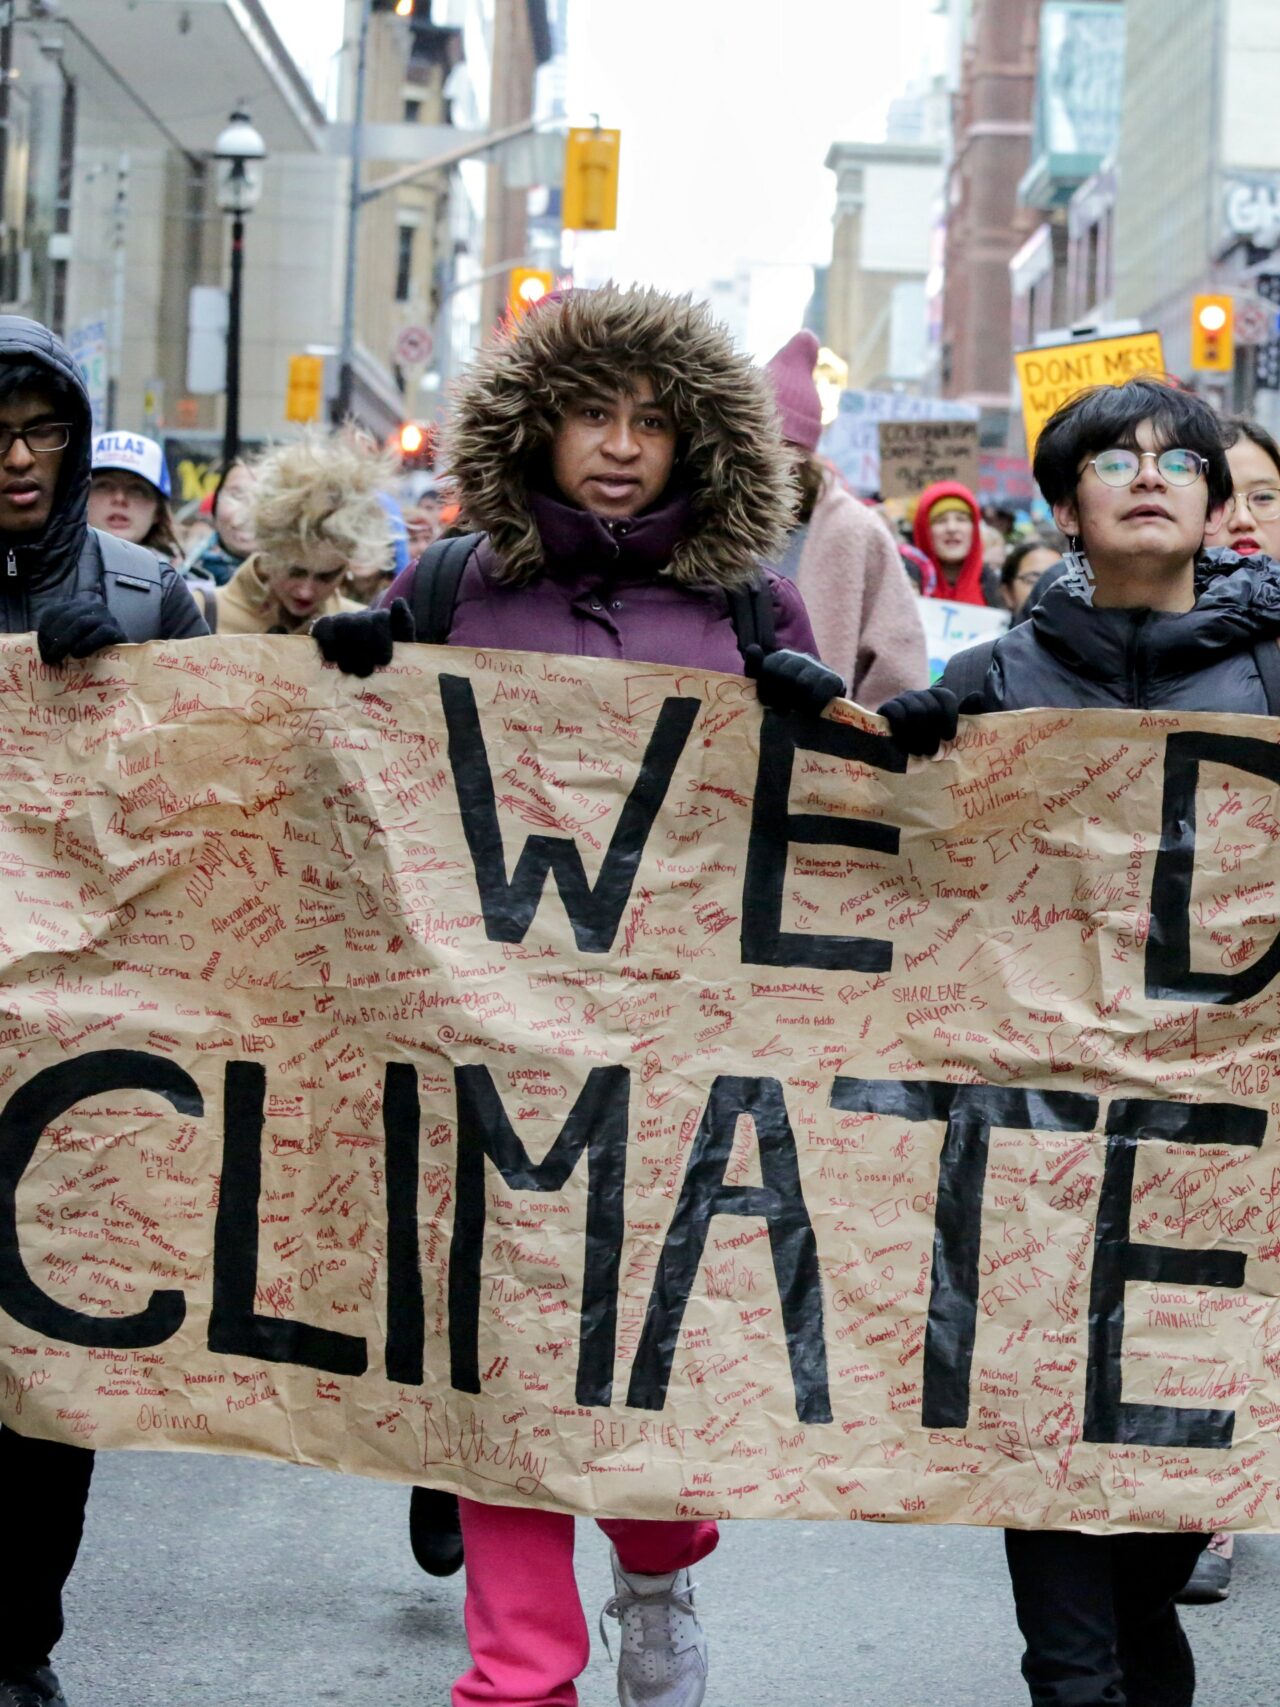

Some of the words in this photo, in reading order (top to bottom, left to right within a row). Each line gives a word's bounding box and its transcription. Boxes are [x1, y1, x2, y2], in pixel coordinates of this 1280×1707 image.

[1024, 354, 1094, 388] DONT
[1104, 347, 1158, 377] MESS
[95, 436, 145, 455] ATLAS
[474, 652, 522, 675] Olivia
[1139, 716, 1181, 728] Alissa
[438, 673, 907, 972] WE
[892, 984, 967, 1002] SHARLENE
[0, 1049, 1268, 1449] CLIMATE
[832, 1277, 882, 1312] Grace
[137, 1403, 213, 1435] Obinna
[1070, 1509, 1110, 1522] Alison
